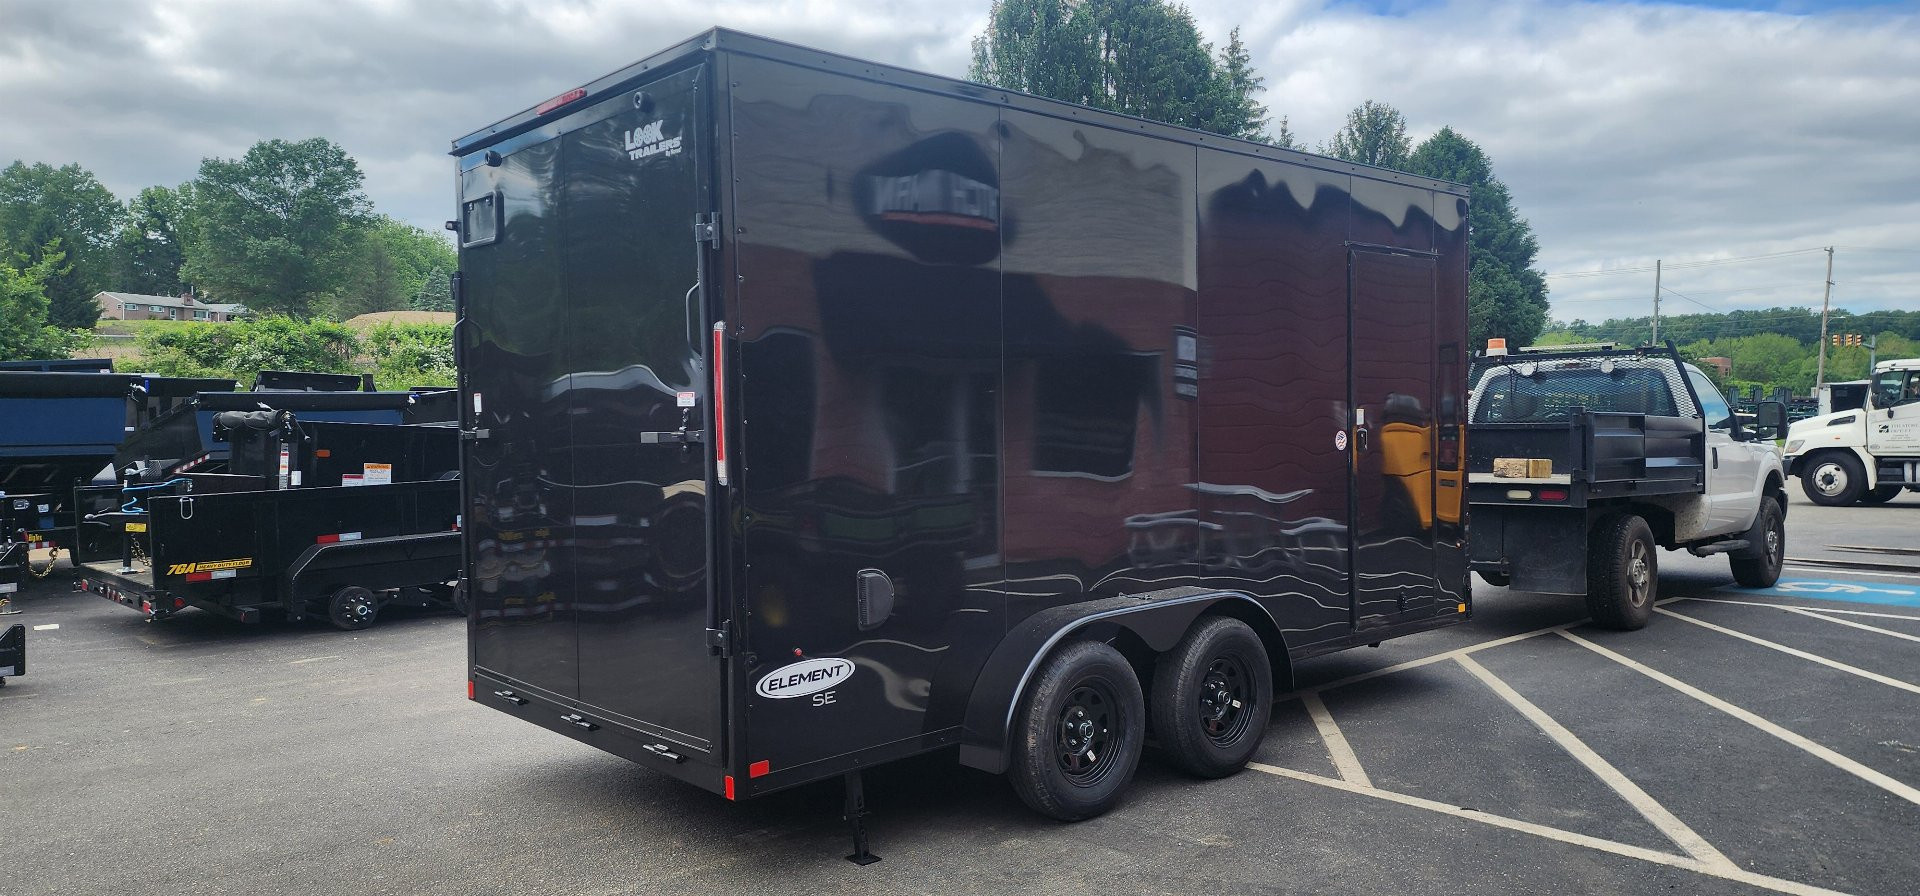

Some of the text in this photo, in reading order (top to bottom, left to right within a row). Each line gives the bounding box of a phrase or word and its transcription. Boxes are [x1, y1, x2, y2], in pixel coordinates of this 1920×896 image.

[624, 119, 664, 151] LOOK
[628, 136, 682, 161] TRAILERS
[768, 665, 844, 691] ELEMENT
[812, 690, 837, 707] SE
